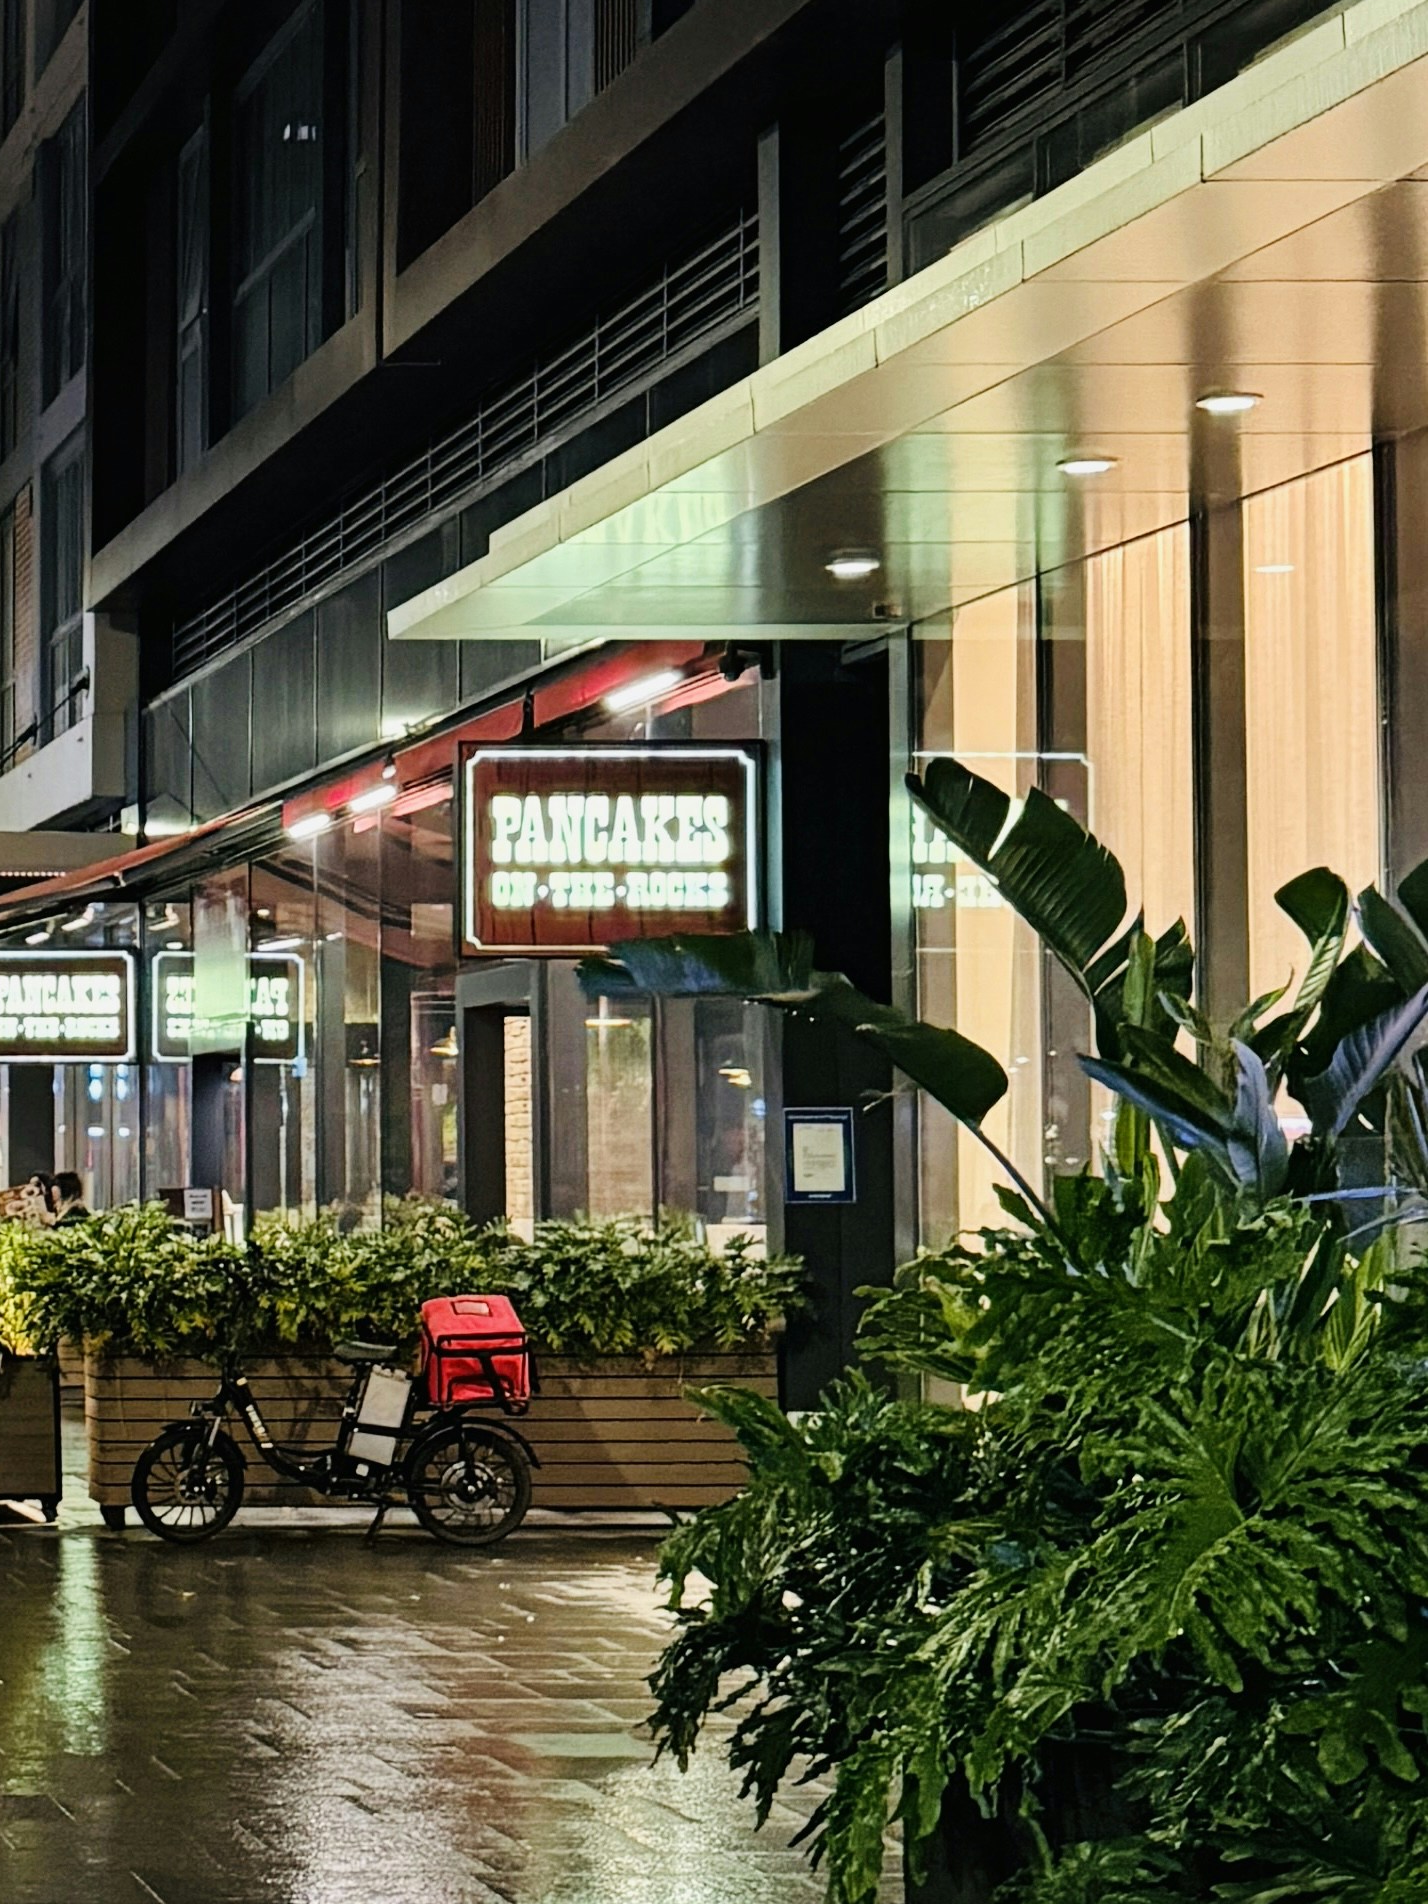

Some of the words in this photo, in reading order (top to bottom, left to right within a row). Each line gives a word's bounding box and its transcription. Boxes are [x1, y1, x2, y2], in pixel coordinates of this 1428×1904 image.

[491, 793, 730, 864] PANCAKES
[491, 871, 538, 908] ON
[548, 871, 615, 908] THE
[626, 871, 730, 908] ROCKS
